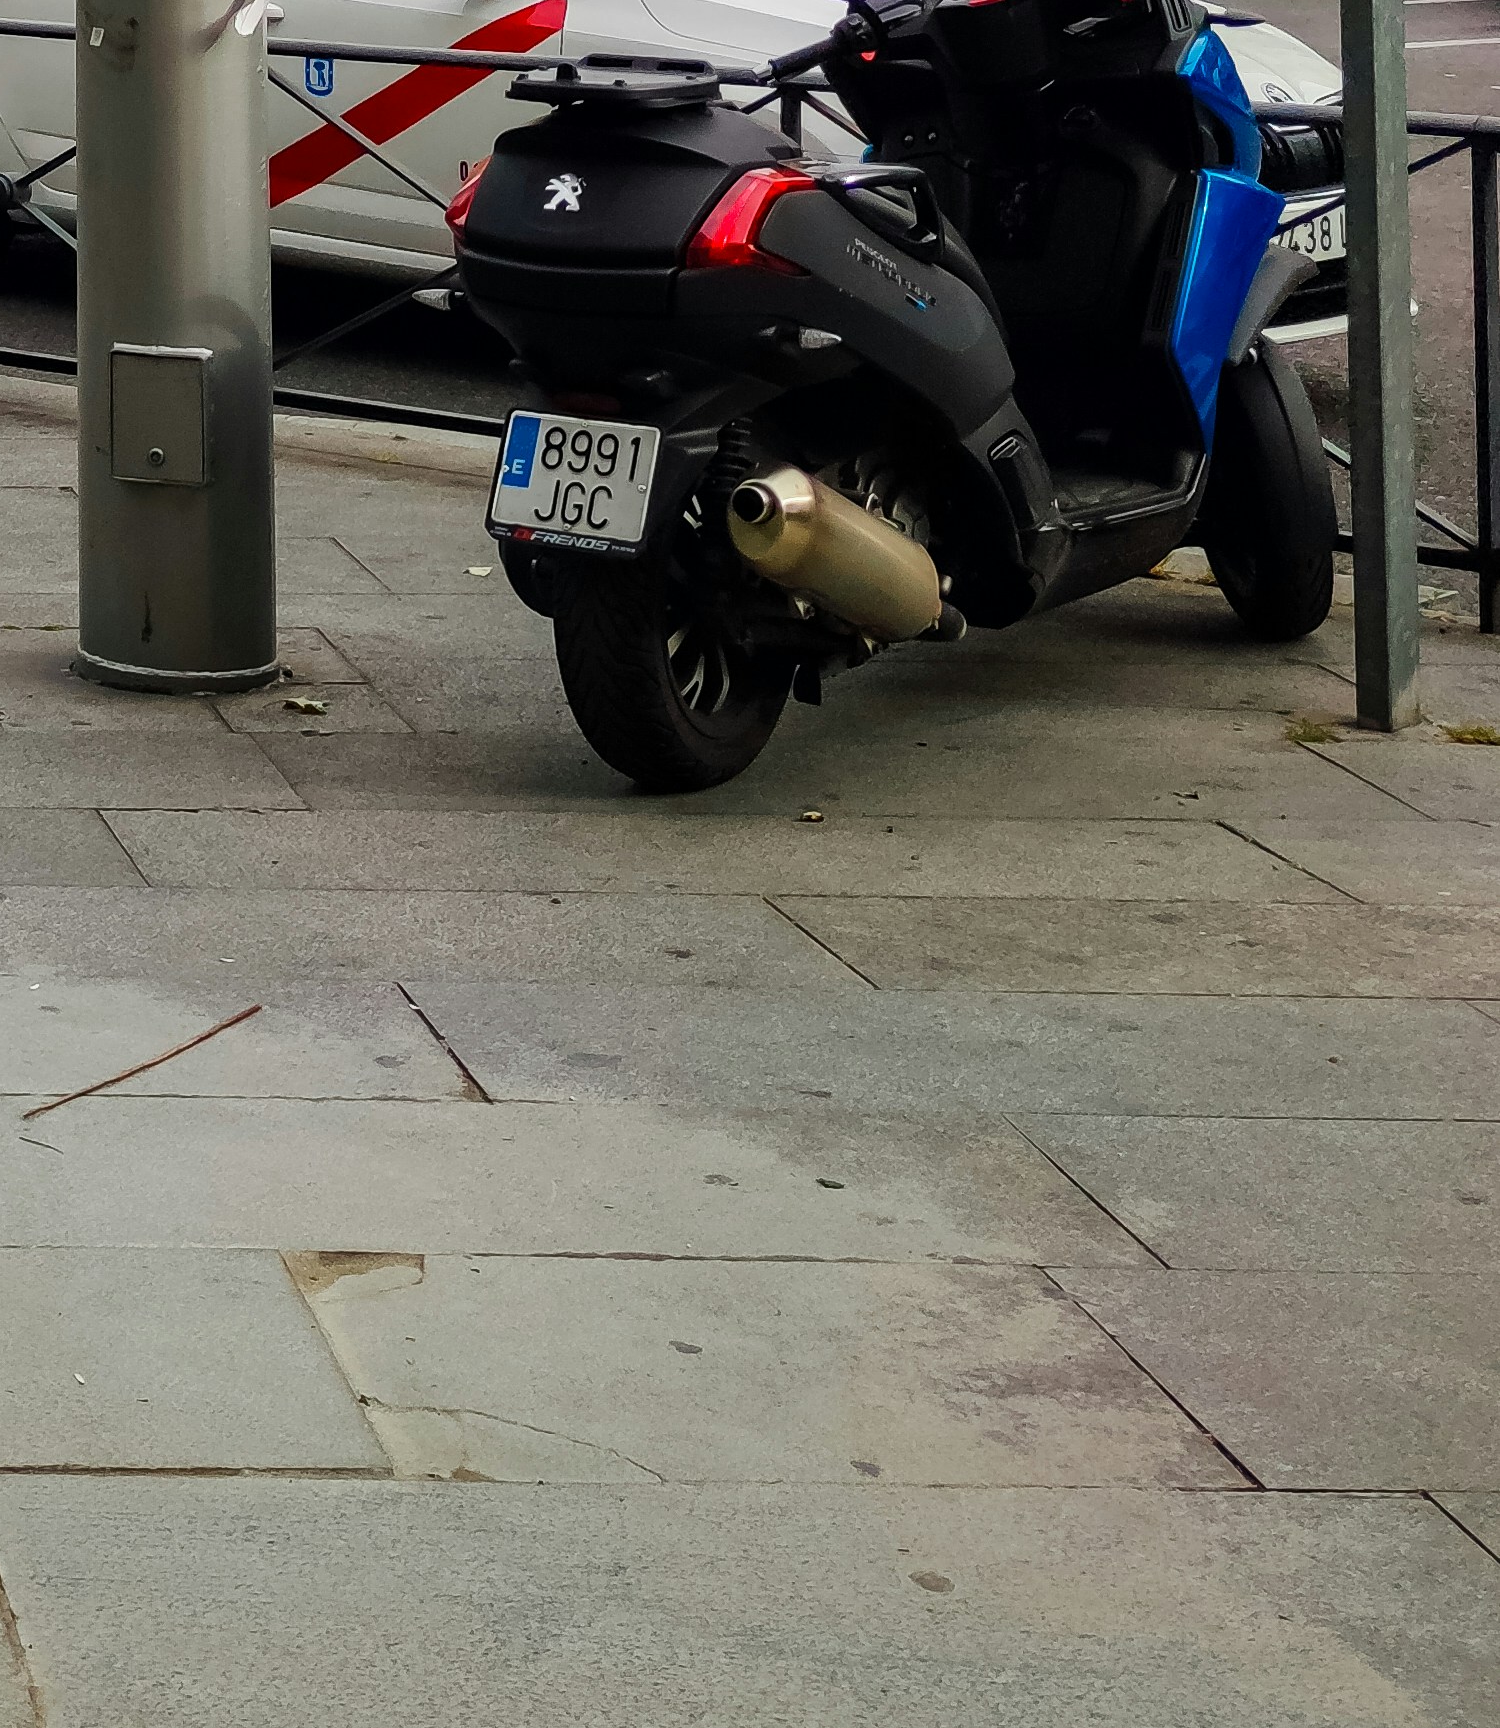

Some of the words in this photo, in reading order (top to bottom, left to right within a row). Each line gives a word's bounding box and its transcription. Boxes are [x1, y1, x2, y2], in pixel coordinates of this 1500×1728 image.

[511, 458, 526, 475] E
[540, 426, 643, 483] 8991
[533, 478, 614, 530] JGC
